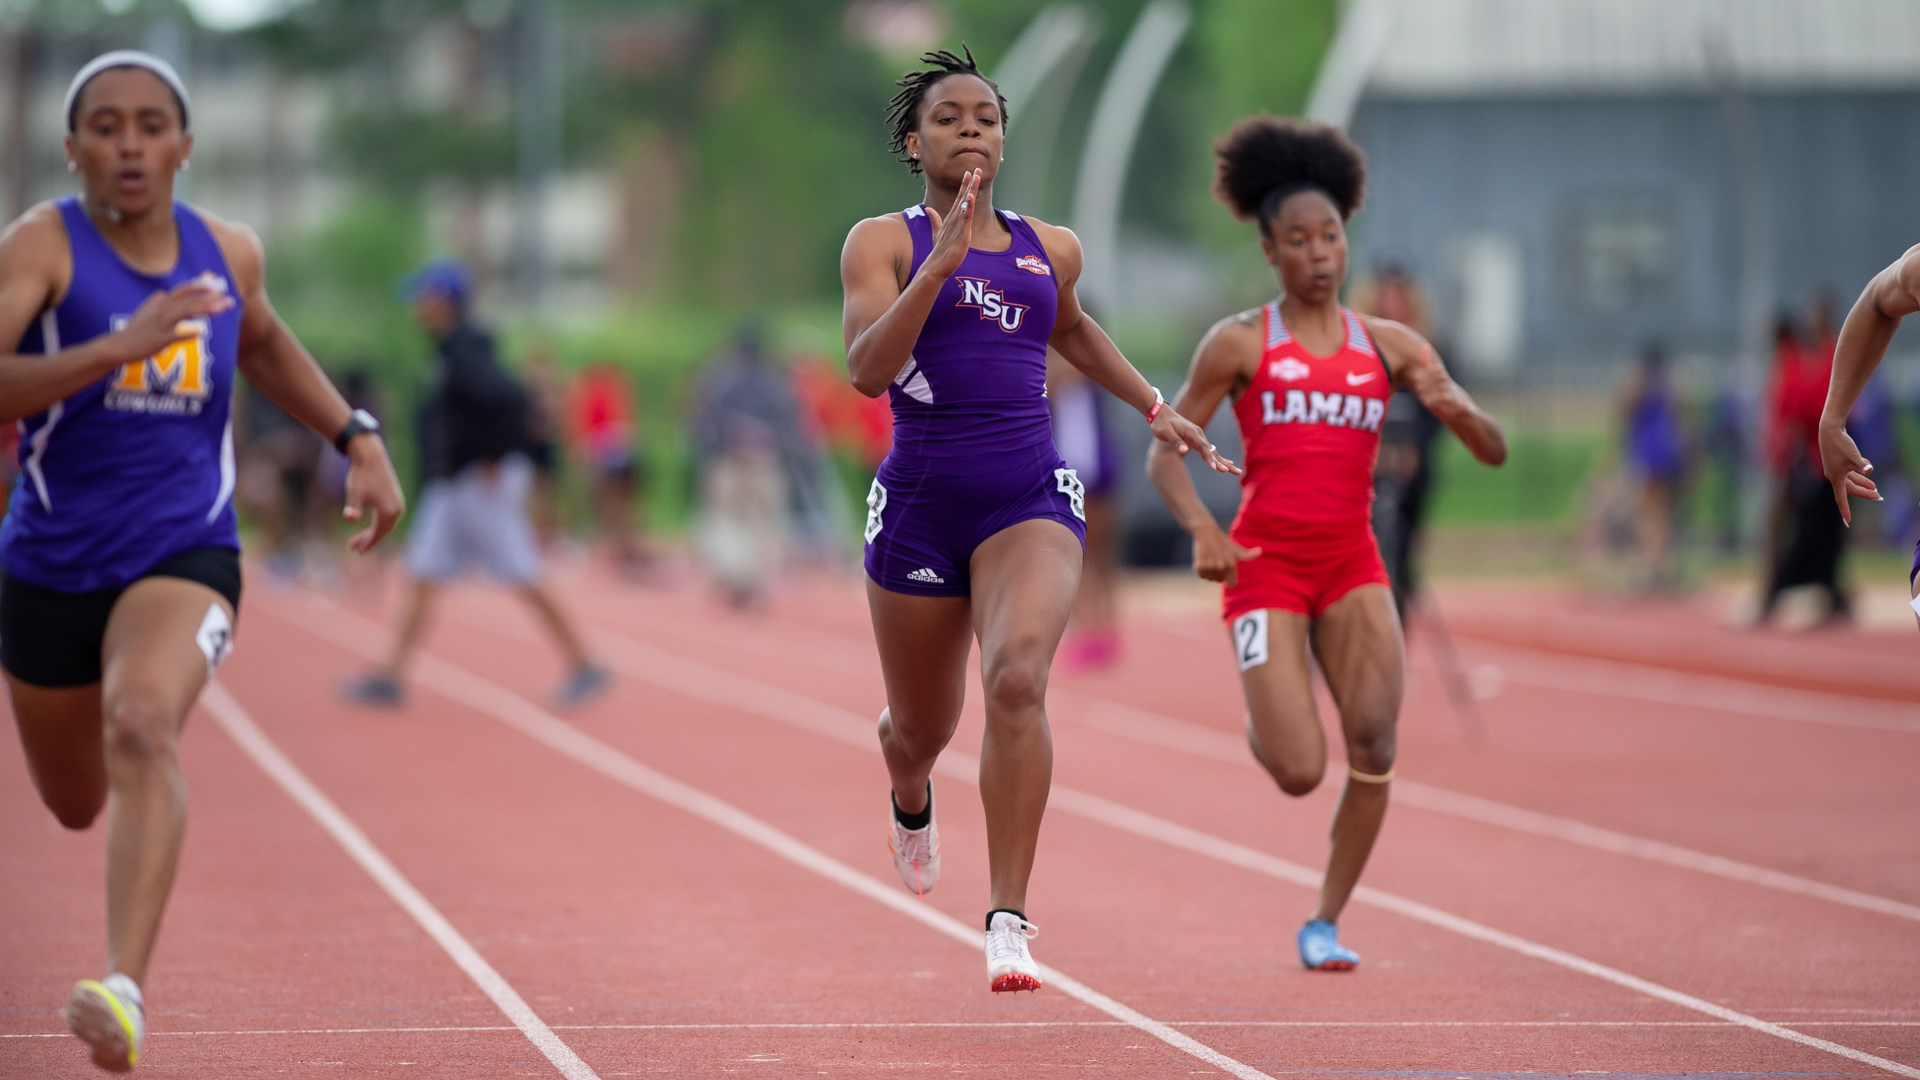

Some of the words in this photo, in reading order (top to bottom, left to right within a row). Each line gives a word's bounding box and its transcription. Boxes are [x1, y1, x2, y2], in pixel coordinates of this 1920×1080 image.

[962, 279, 1023, 330] NSU
[113, 316, 210, 396] M
[1261, 389, 1384, 432] LAMAR
[907, 573, 944, 584] adidas
[1241, 618, 1259, 662] 2
